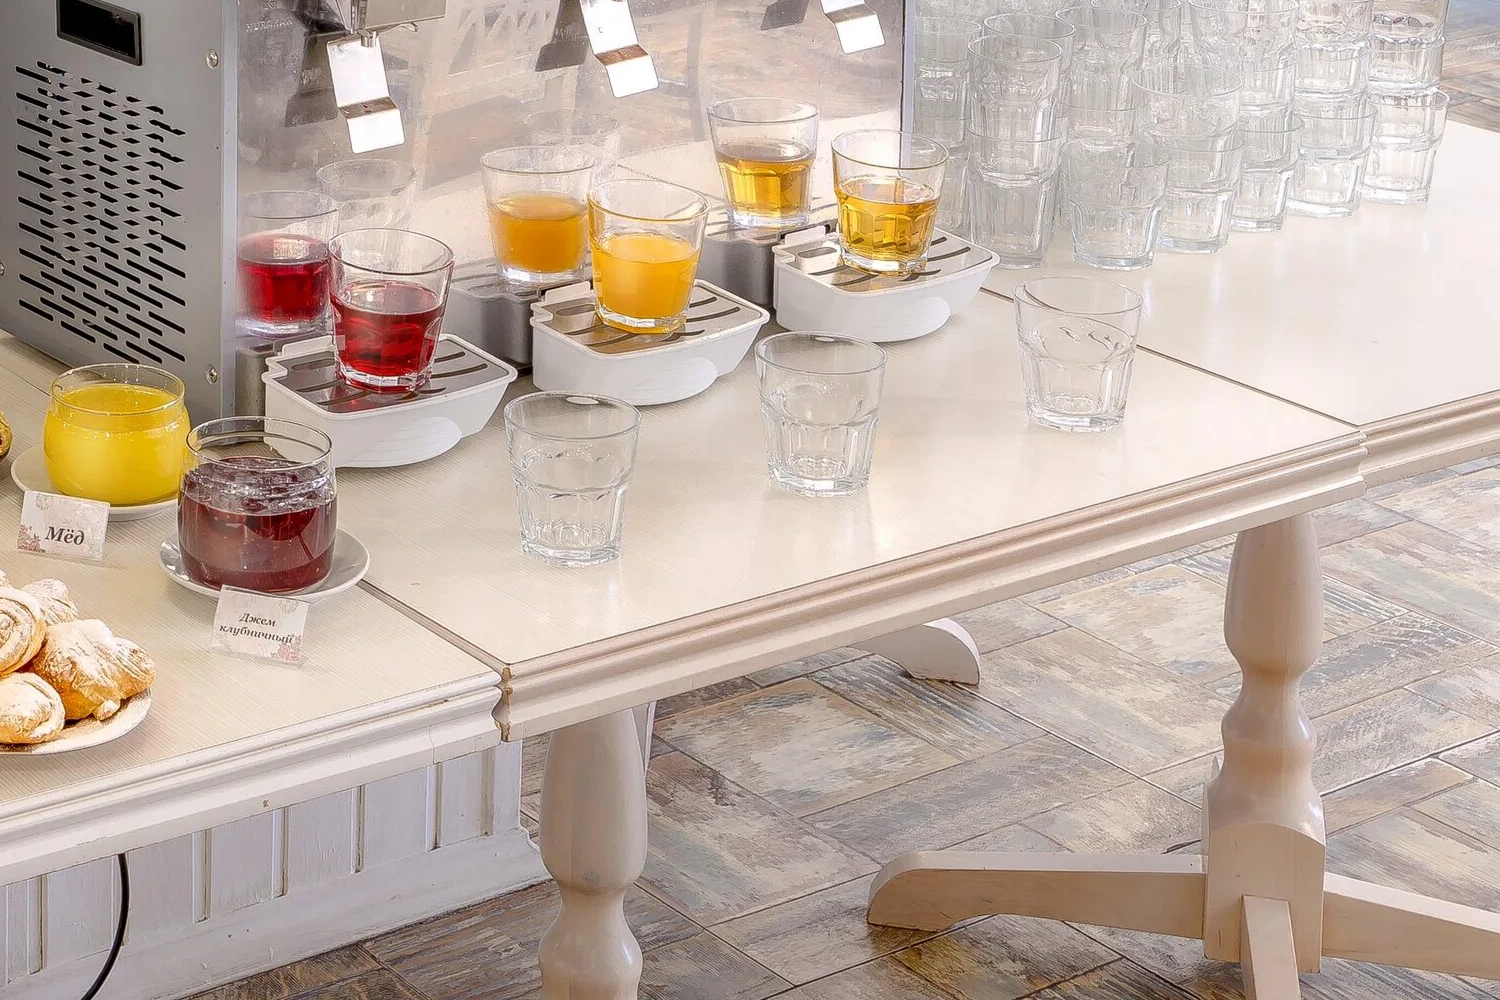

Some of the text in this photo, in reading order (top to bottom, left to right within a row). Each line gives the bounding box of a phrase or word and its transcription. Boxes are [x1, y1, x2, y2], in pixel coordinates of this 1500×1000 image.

[44, 526, 85, 545] Мёд
[239, 612, 276, 627] Джем
[219, 625, 294, 644] клубничный
